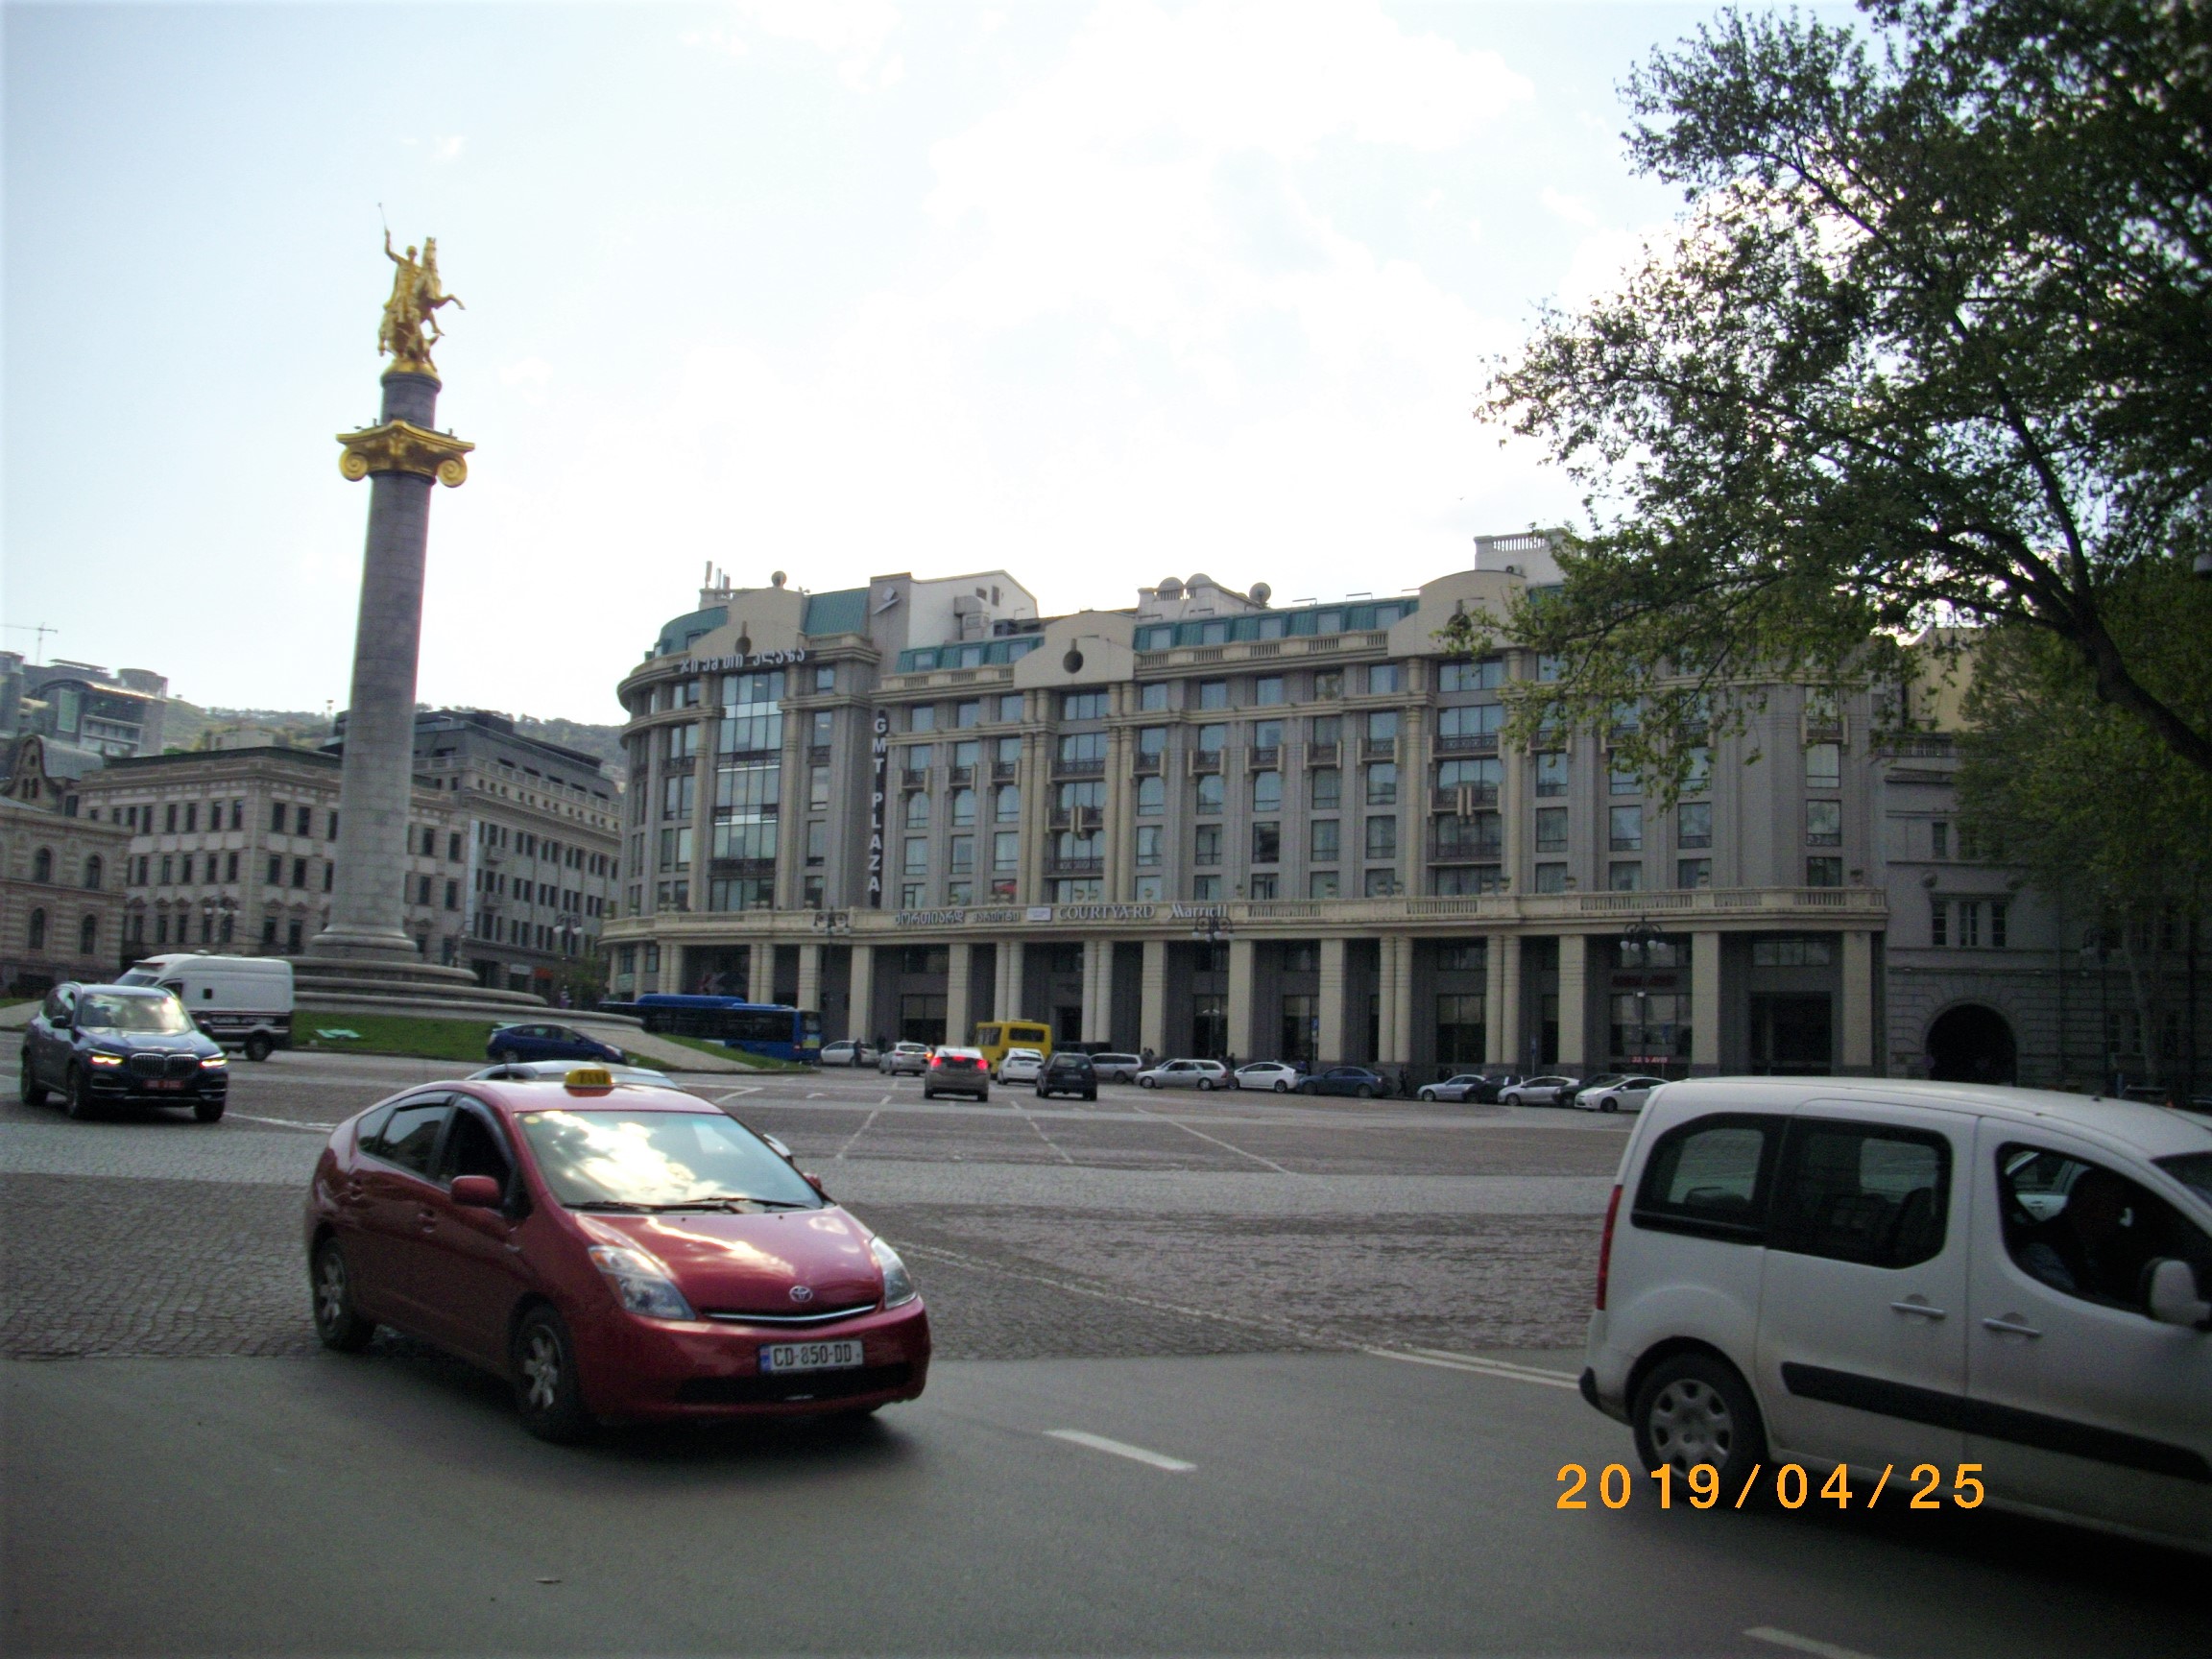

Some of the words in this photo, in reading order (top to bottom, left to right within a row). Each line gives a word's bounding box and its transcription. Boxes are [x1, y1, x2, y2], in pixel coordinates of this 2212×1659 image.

[872, 717, 888, 774] GMT
[868, 792, 883, 892] PLAZA
[1058, 905, 1156, 921] COURTYARD
